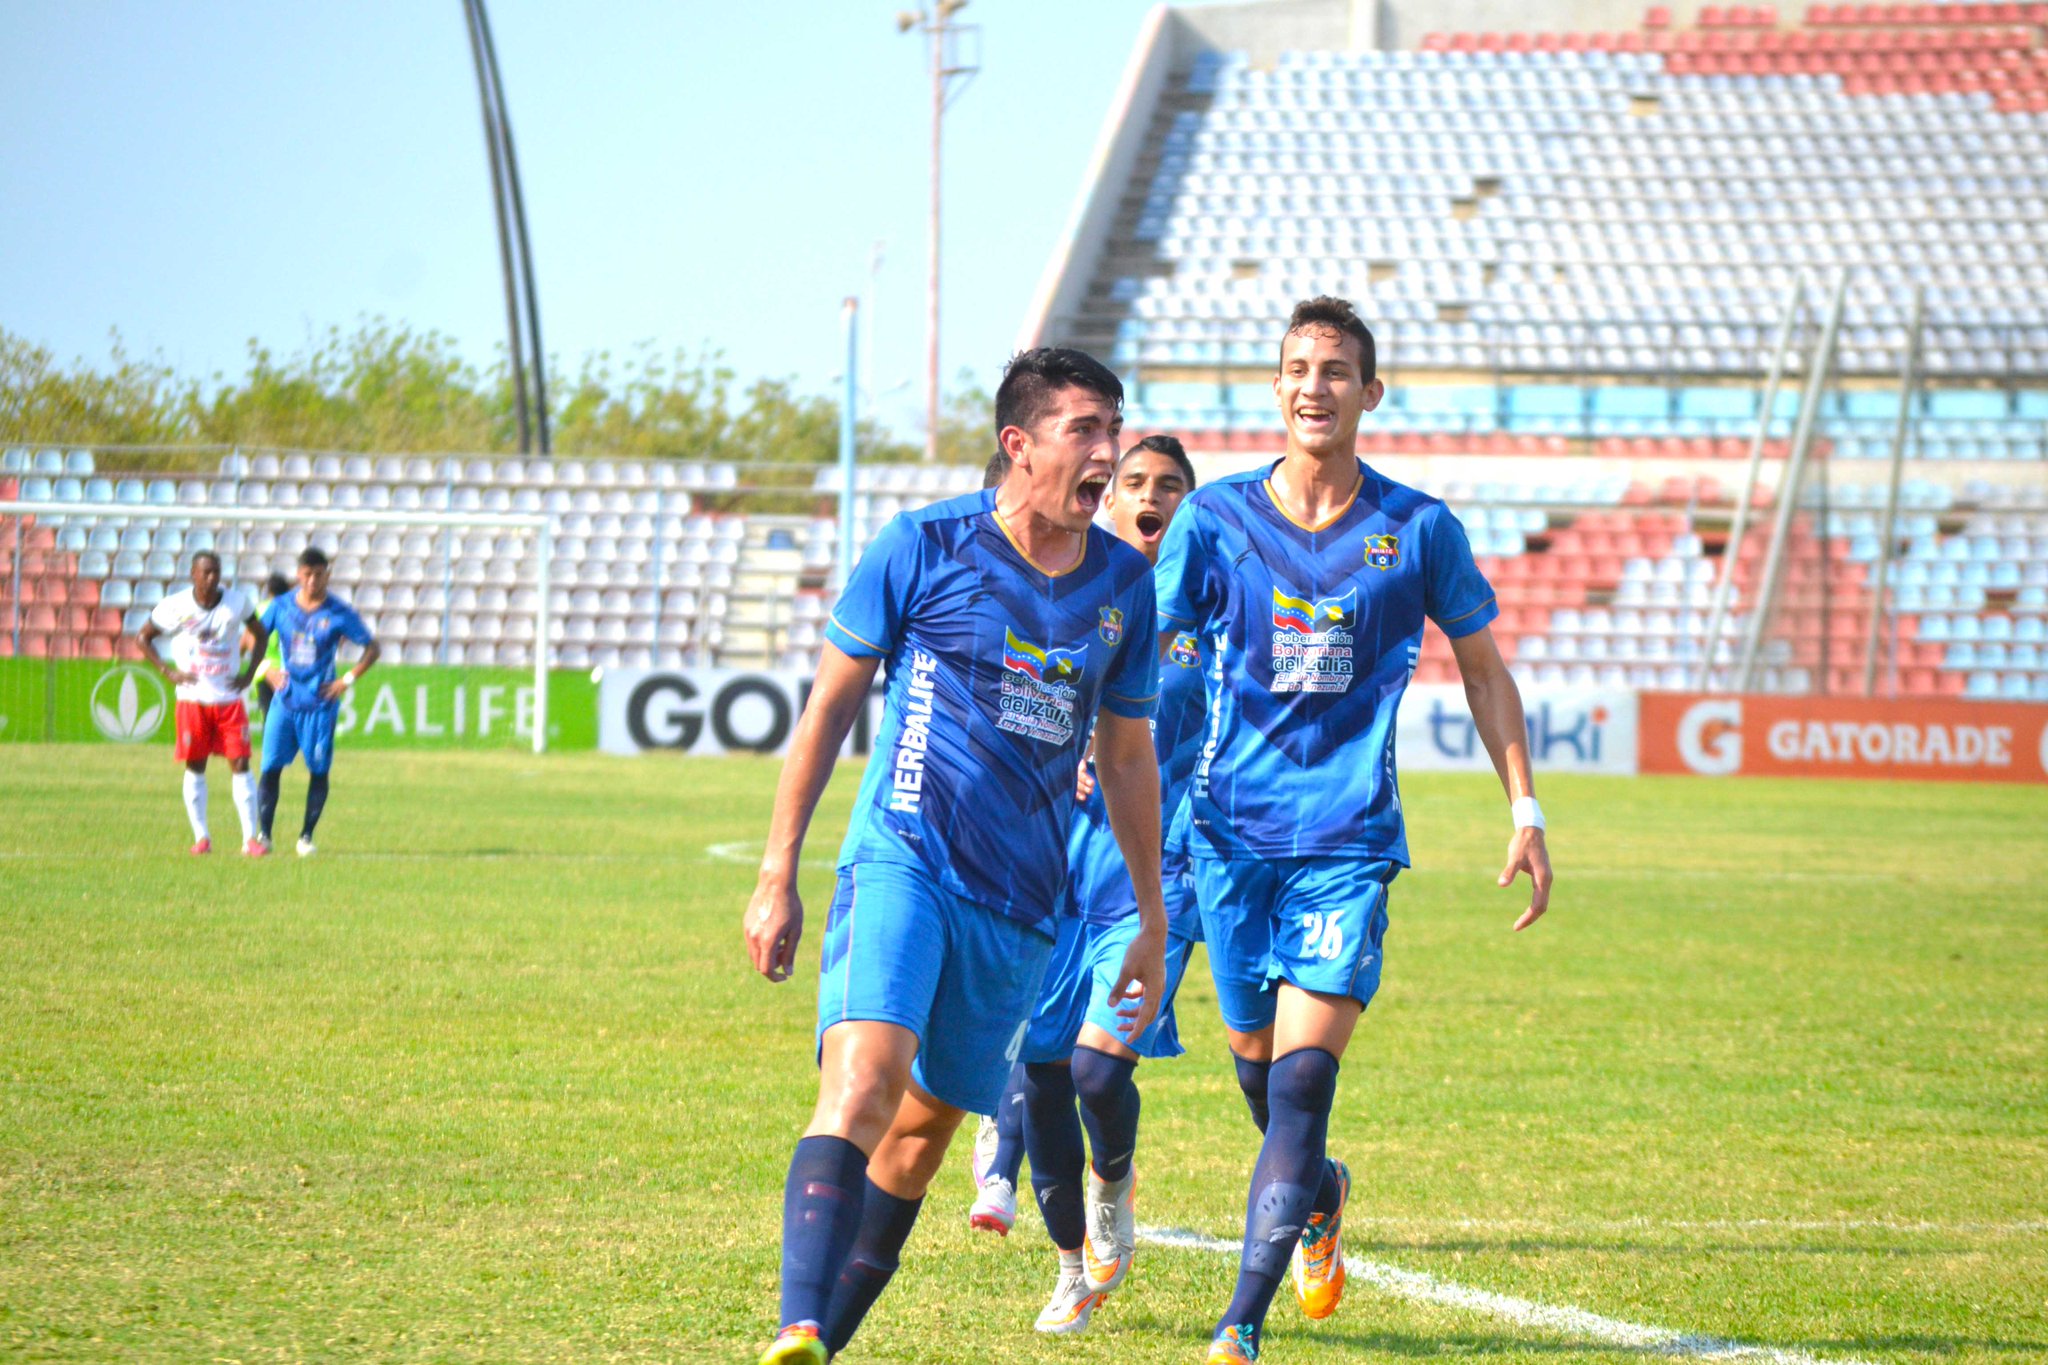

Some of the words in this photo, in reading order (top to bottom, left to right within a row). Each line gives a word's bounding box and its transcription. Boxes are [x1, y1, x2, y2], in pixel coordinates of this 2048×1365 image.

[1273, 657, 1301, 672] del
[1303, 657, 1353, 673] Zulia
[1000, 694, 1029, 714] del
[889, 650, 937, 813] HERBALIFE
[1428, 700, 1609, 761] trki
[1767, 720, 2013, 765] GATORADE
[1298, 910, 1344, 960] 26
